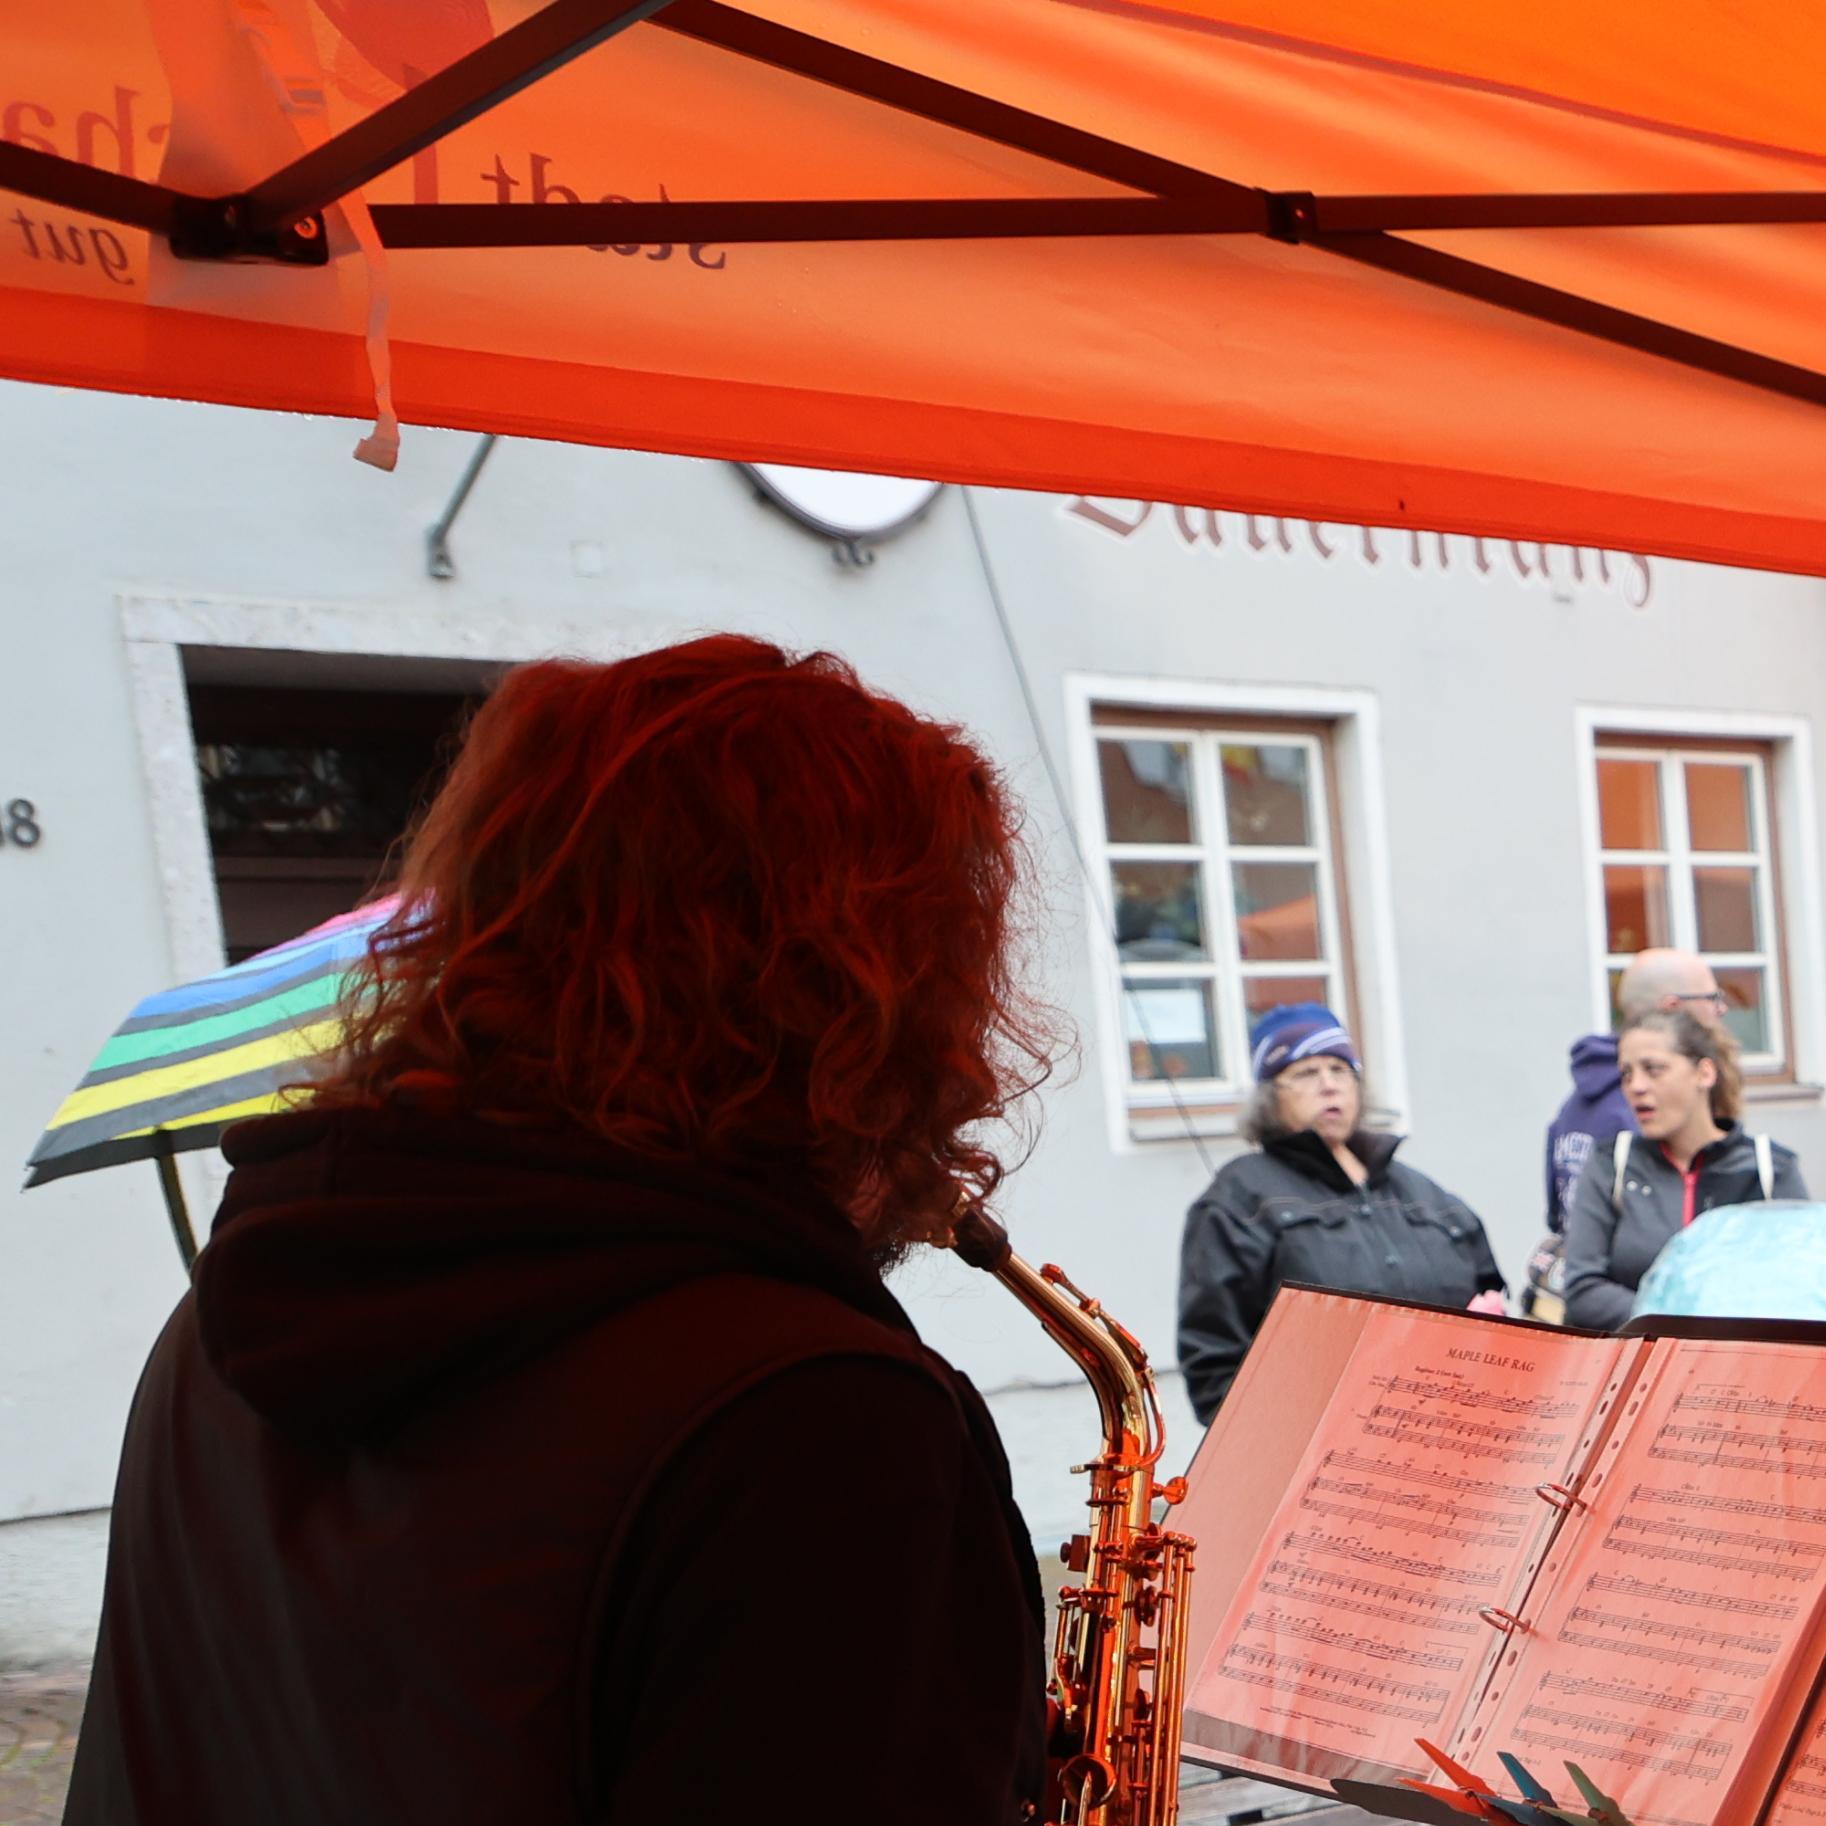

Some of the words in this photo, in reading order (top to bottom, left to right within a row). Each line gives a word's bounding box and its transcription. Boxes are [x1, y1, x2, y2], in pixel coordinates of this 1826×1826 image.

[0, 798, 41, 849] 8
[1446, 1347, 1481, 1363] MAPLE
[1483, 1353, 1510, 1367] LEAF
[1511, 1359, 1536, 1373] RAG
